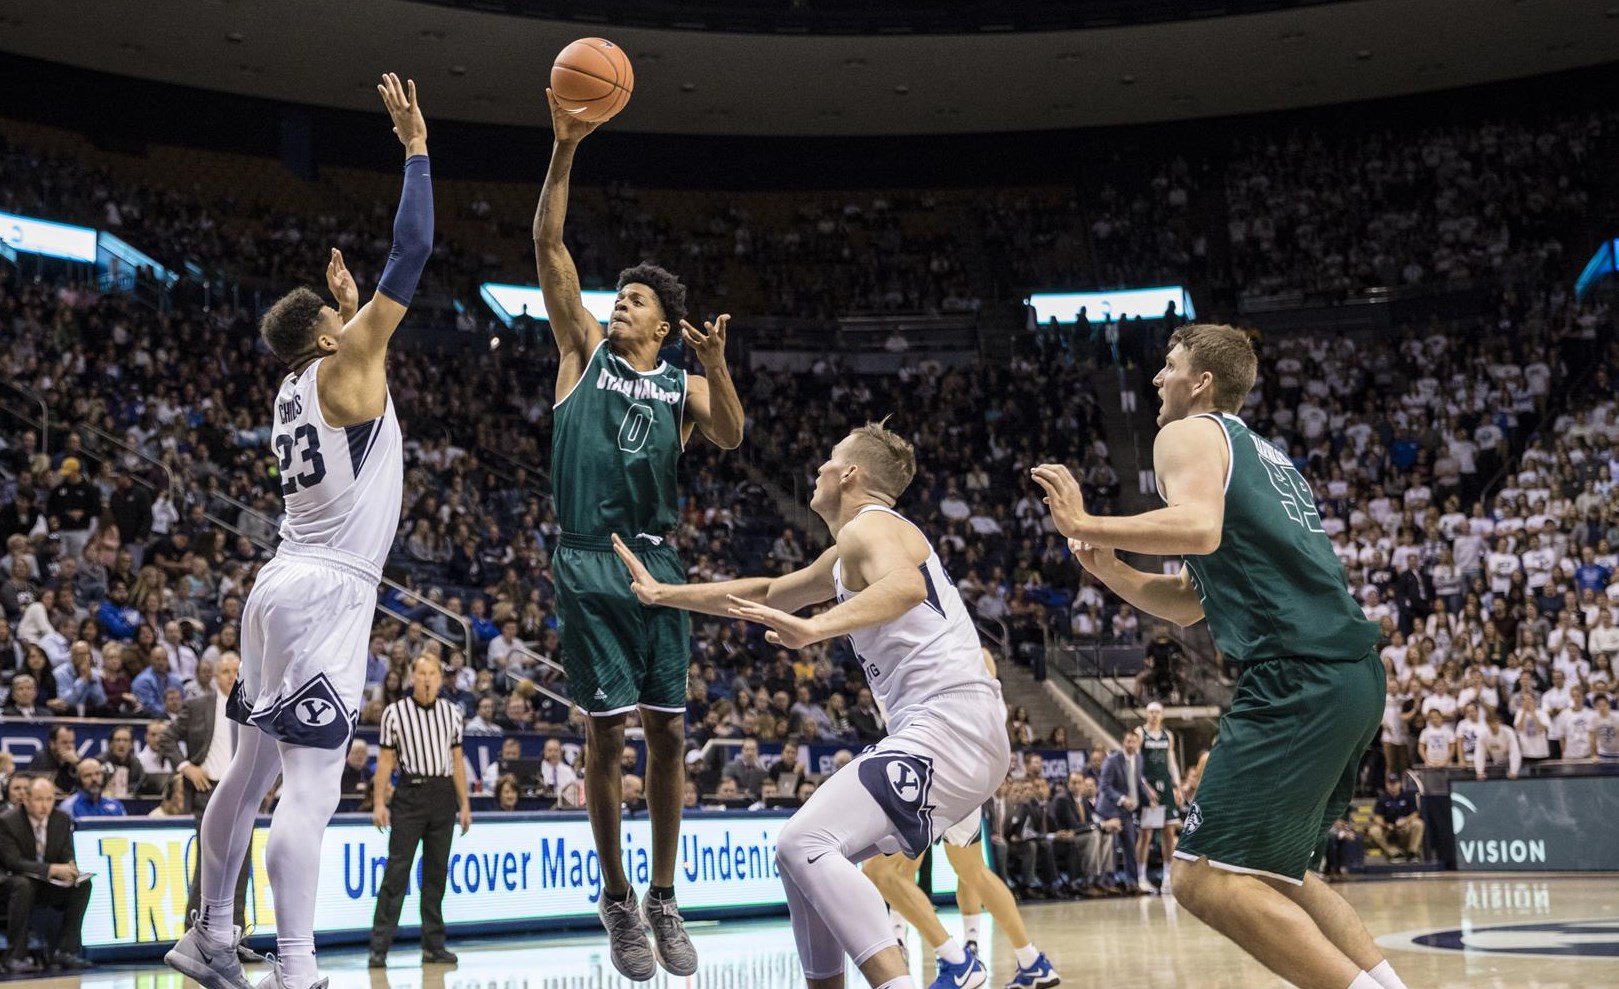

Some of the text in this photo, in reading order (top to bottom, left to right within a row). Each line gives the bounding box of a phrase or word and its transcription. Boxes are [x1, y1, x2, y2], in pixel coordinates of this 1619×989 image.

[618, 403, 653, 453] 0
[276, 423, 326, 495] 23
[344, 843, 531, 899] Uncover
[541, 832, 649, 903] Magia
[1460, 840, 1546, 863] VISION
